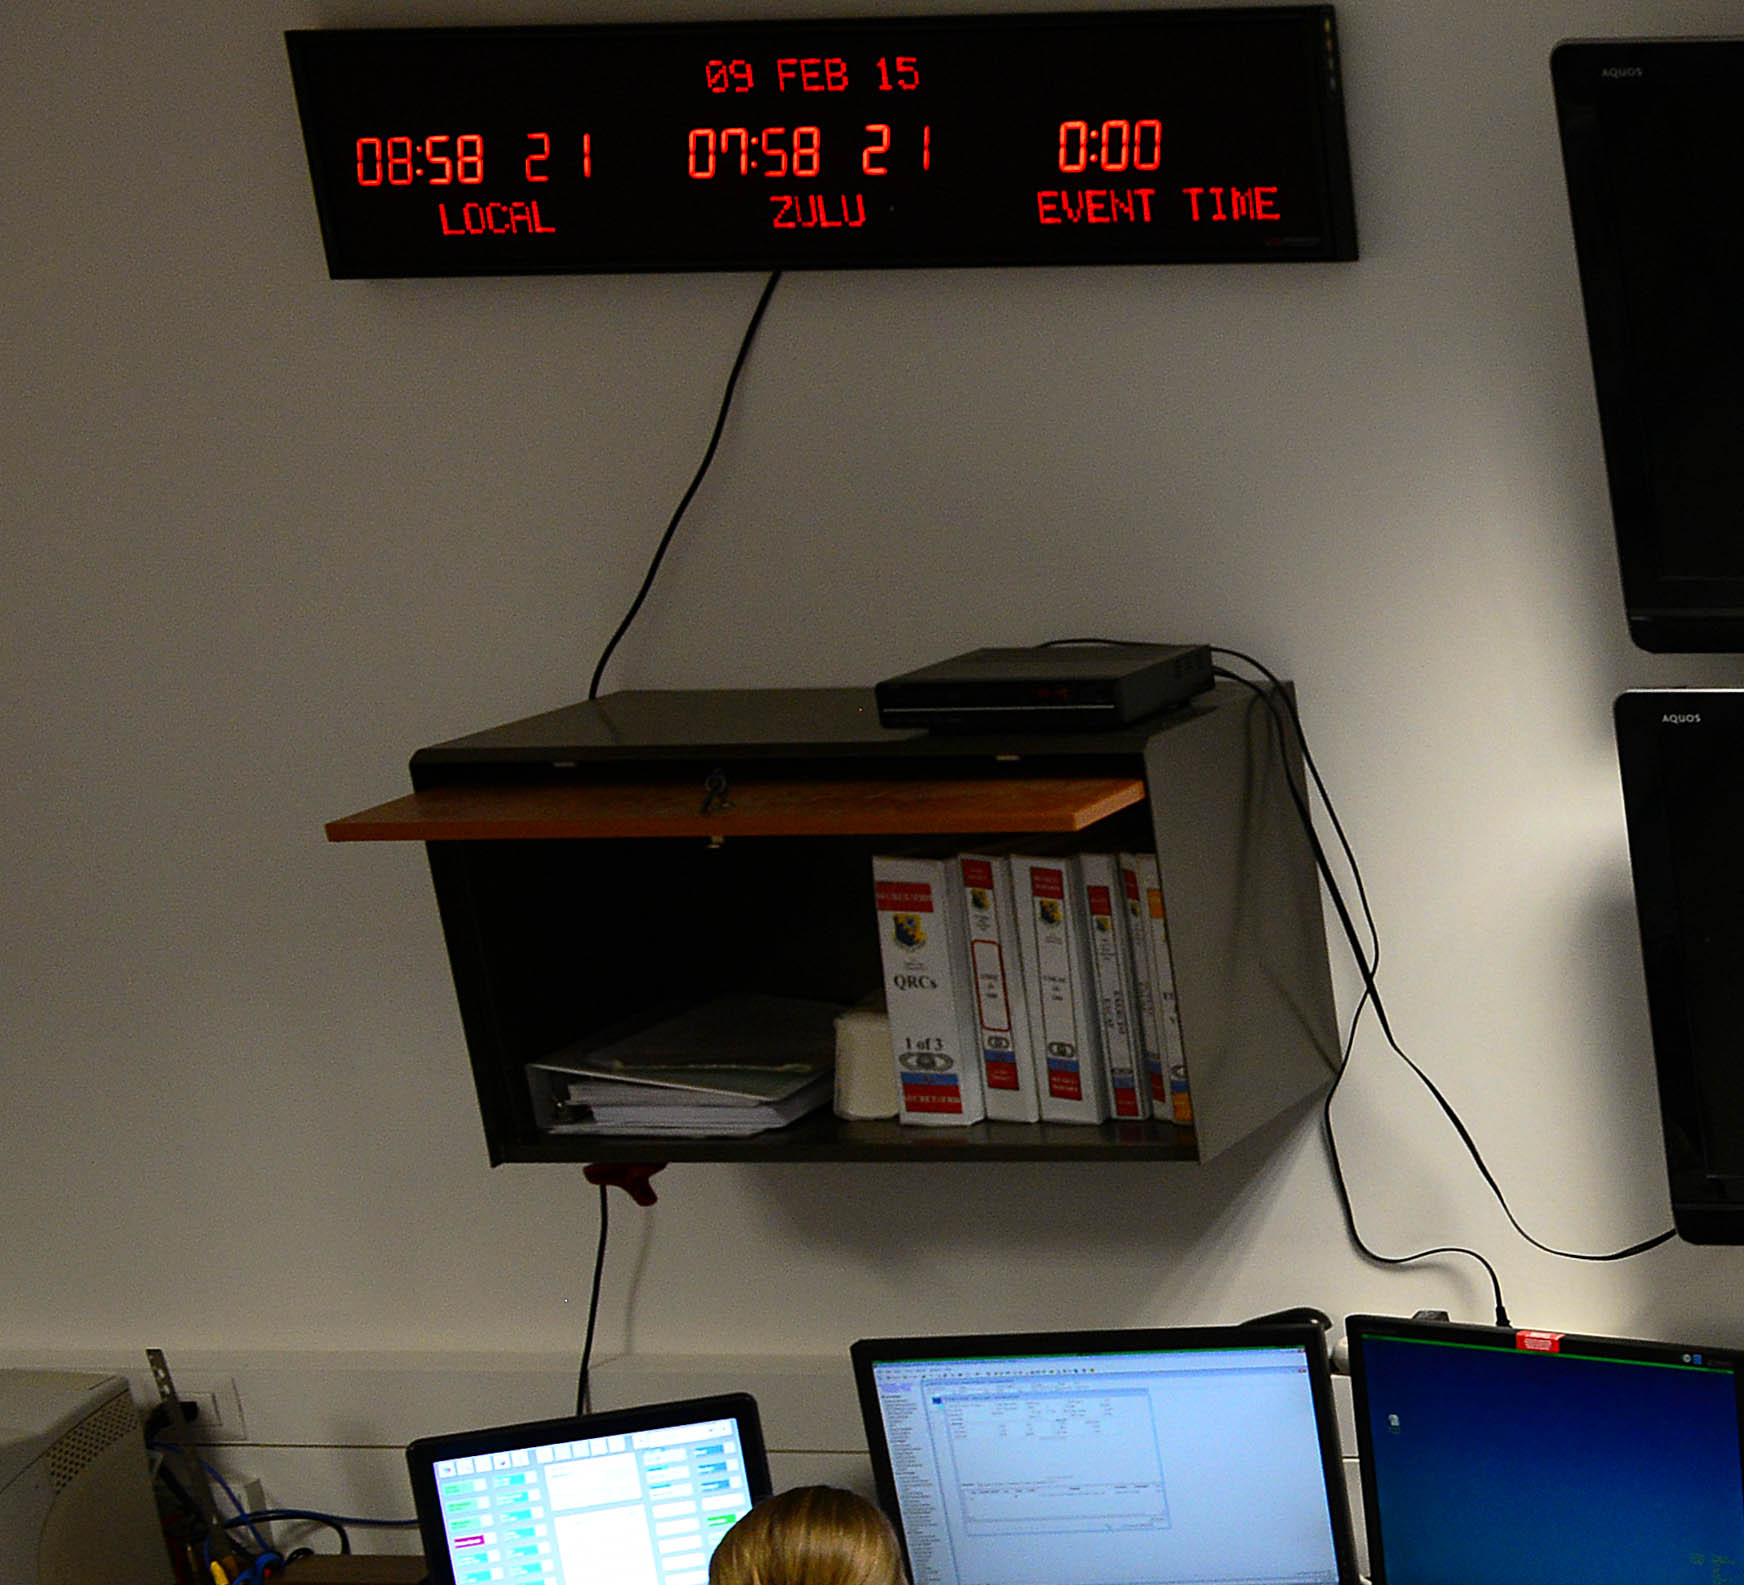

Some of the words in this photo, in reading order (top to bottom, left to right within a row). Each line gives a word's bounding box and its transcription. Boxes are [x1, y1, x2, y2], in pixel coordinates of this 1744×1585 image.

[705, 59, 755, 94] 09
[776, 57, 849, 92] FEB
[876, 56, 920, 91] 15
[355, 133, 484, 187] 08:58
[688, 125, 821, 180] 07:58
[1058, 118, 1163, 174] 0:00
[438, 200, 557, 236] LOCAL
[769, 193, 867, 229] ZULU
[1036, 188, 1156, 225] EVENT
[1181, 185, 1281, 222] TIME
[1661, 712, 1703, 724] AQUOS
[893, 973, 939, 991] QRCs
[905, 1037, 912, 1049] 1
[916, 1036, 932, 1050] of
[935, 1037, 944, 1050] 3
